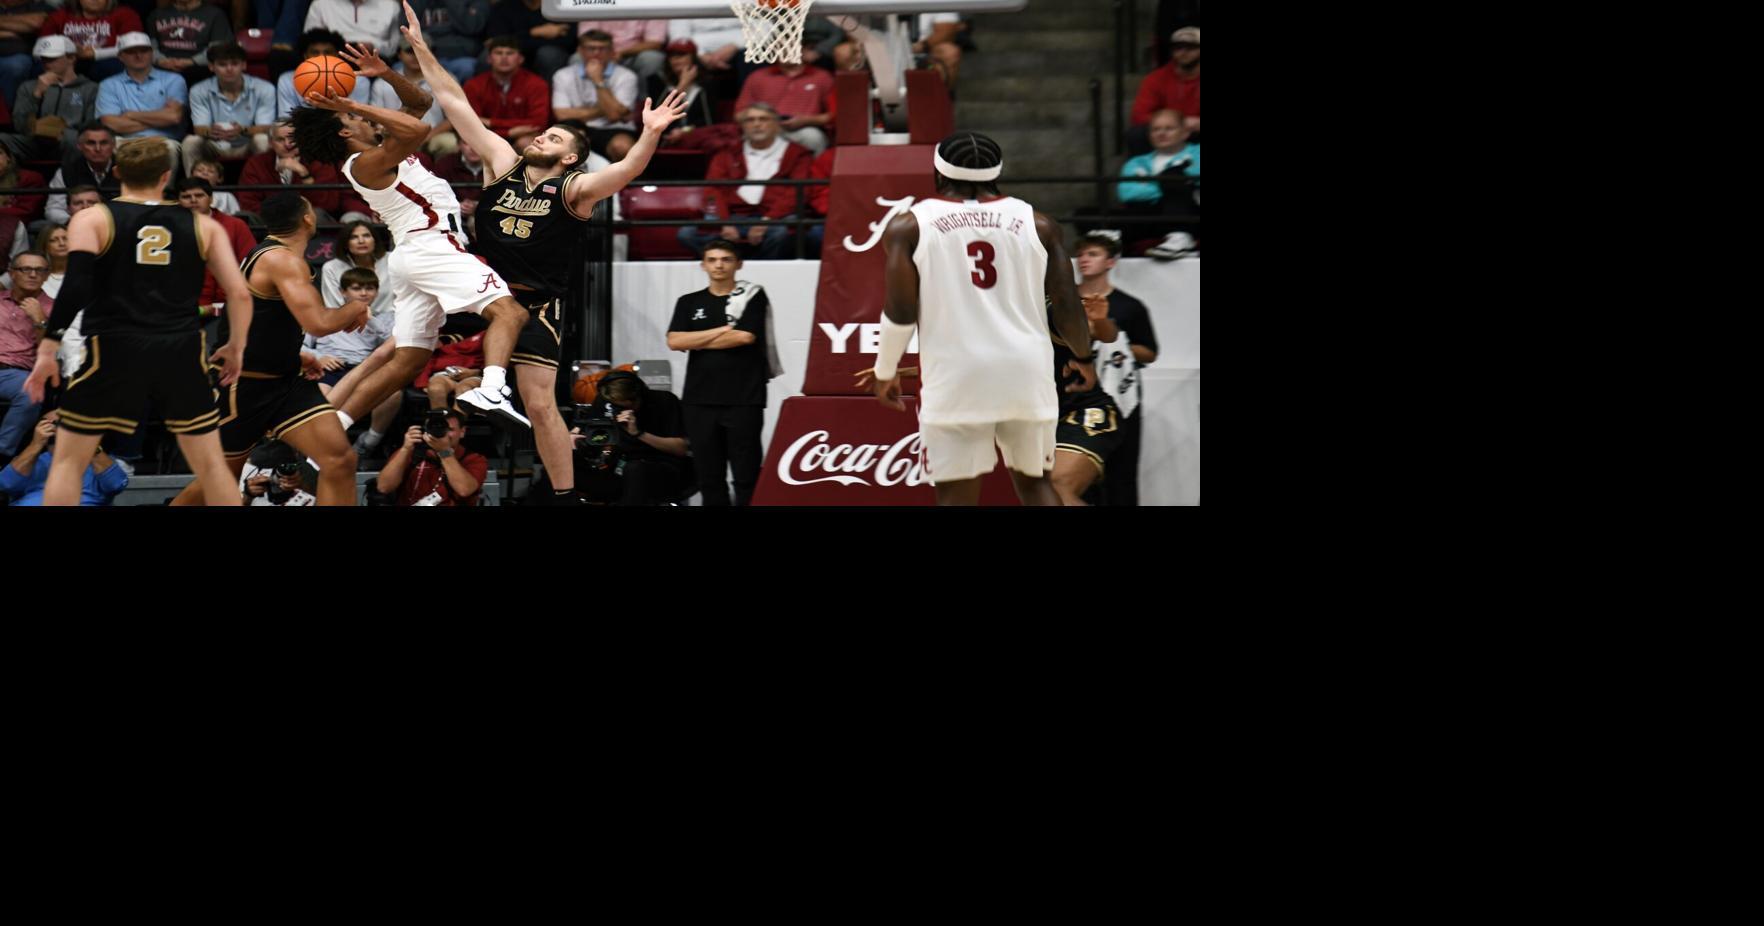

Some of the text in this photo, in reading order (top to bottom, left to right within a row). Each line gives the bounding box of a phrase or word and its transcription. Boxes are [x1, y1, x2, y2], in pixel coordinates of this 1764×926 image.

[492, 188, 552, 216] Purdue
[499, 216, 534, 239] 45
[931, 210, 1002, 234] WRIGHTSELL
[136, 225, 172, 265] 2
[966, 240, 998, 290] 3
